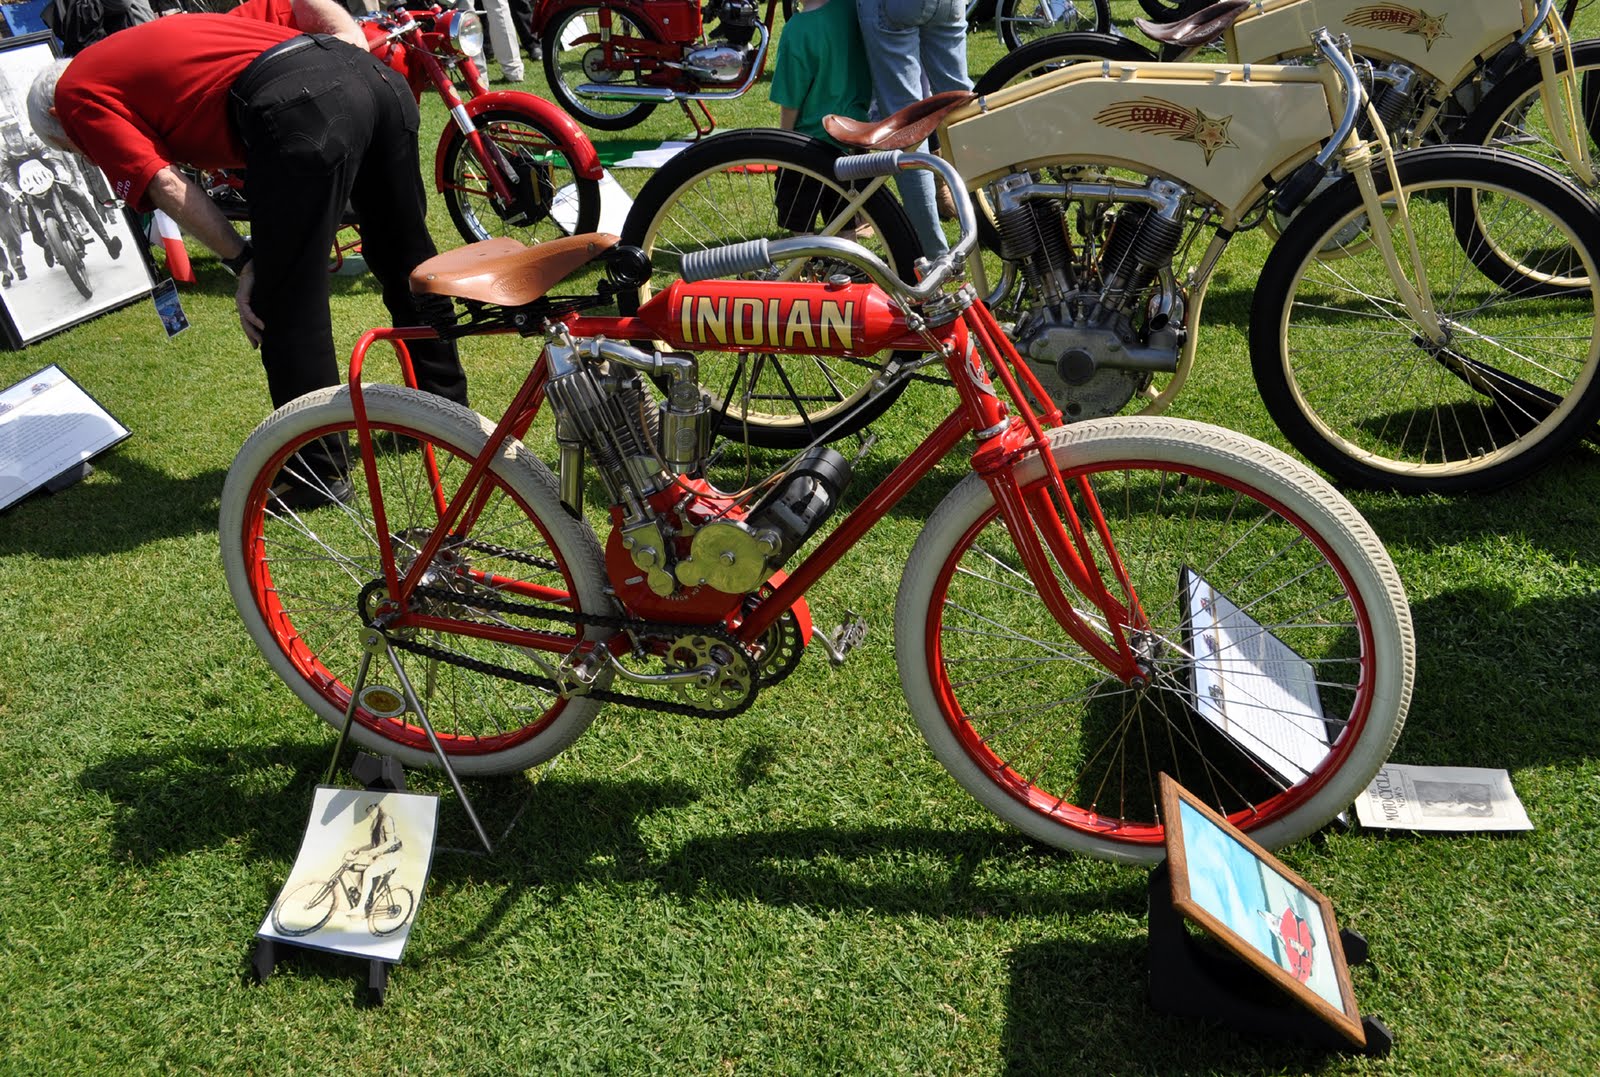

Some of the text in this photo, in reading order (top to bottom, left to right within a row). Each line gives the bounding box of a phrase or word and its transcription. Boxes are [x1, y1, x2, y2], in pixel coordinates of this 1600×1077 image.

[1371, 10, 1416, 26] COMET
[1131, 107, 1190, 130] COMET
[681, 295, 855, 350] INDIAN
[1370, 790, 1379, 803] THE
[1394, 788, 1406, 808] NEWS
